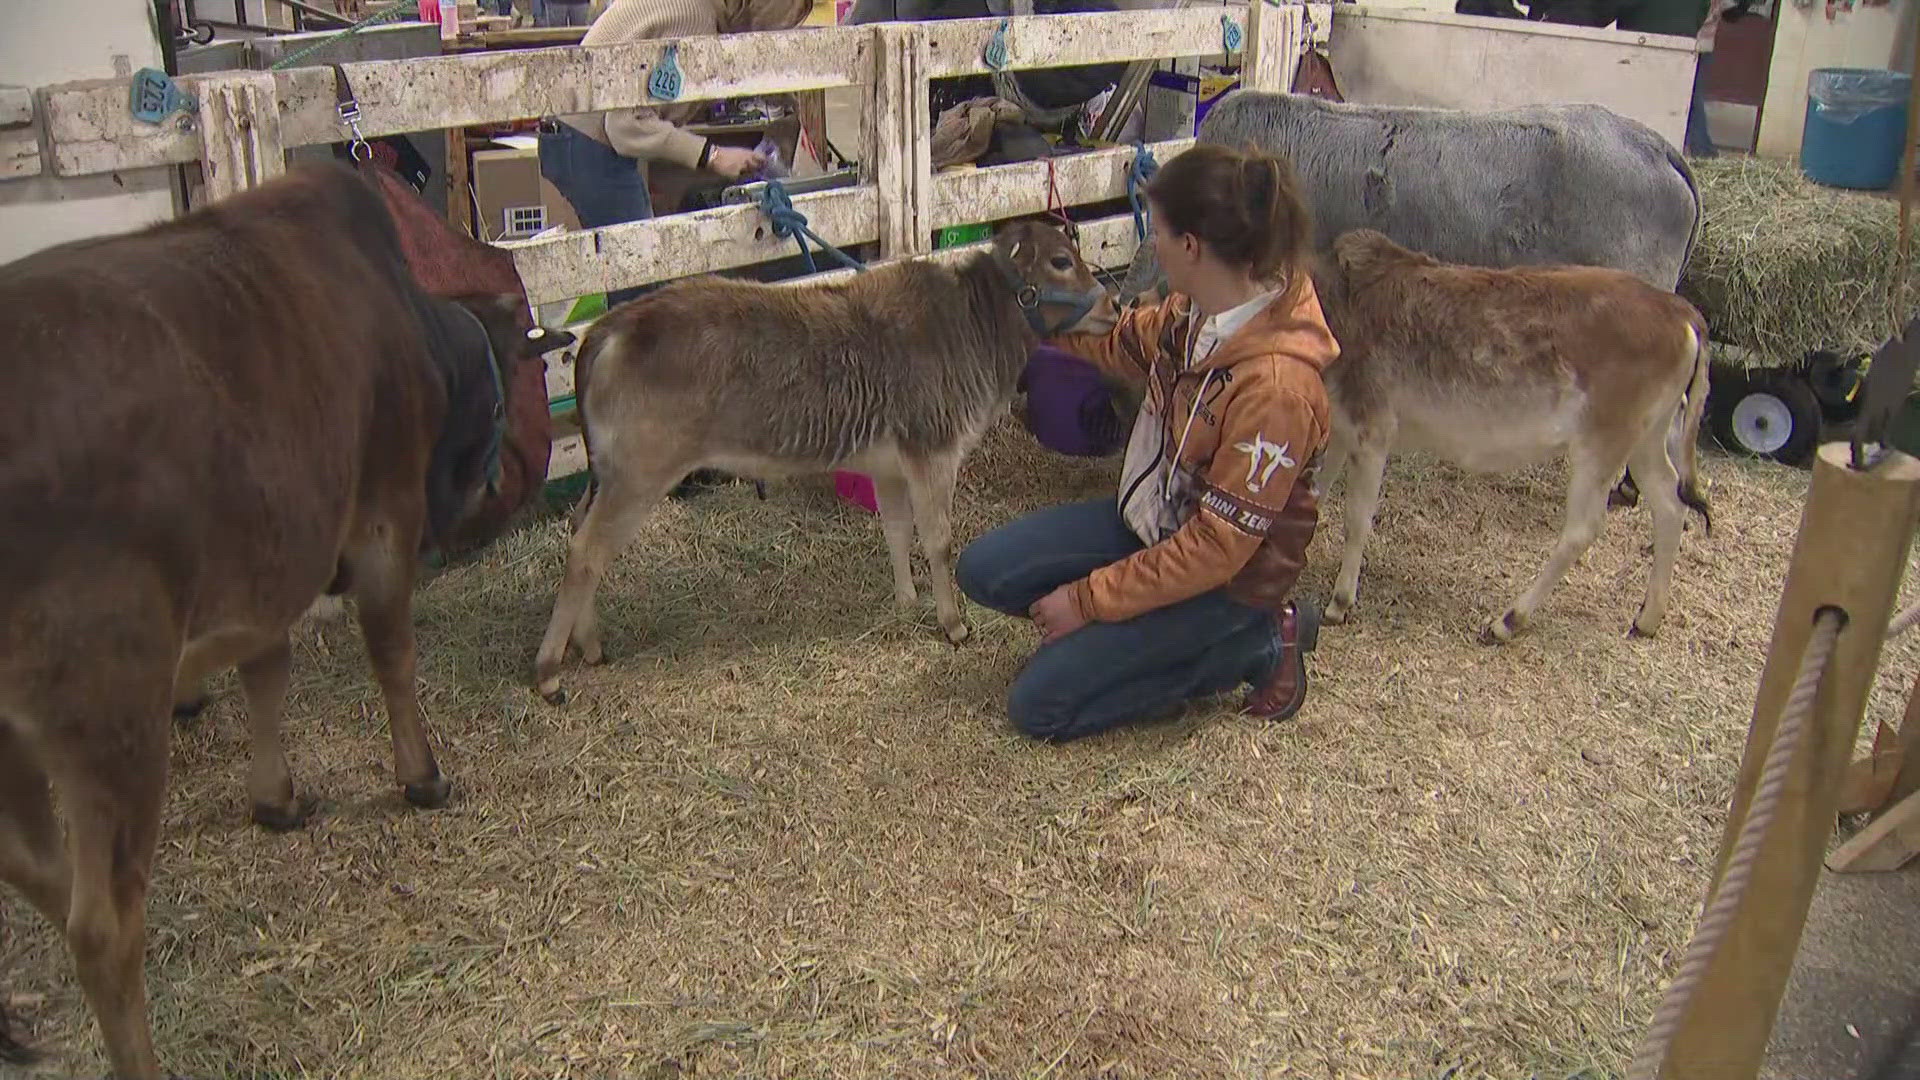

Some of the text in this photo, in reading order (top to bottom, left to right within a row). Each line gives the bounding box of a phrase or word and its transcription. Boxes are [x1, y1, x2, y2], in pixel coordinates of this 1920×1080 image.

[656, 70, 676, 91] 226
[143, 78, 167, 115] 225
[1201, 491, 1237, 517] MINI
